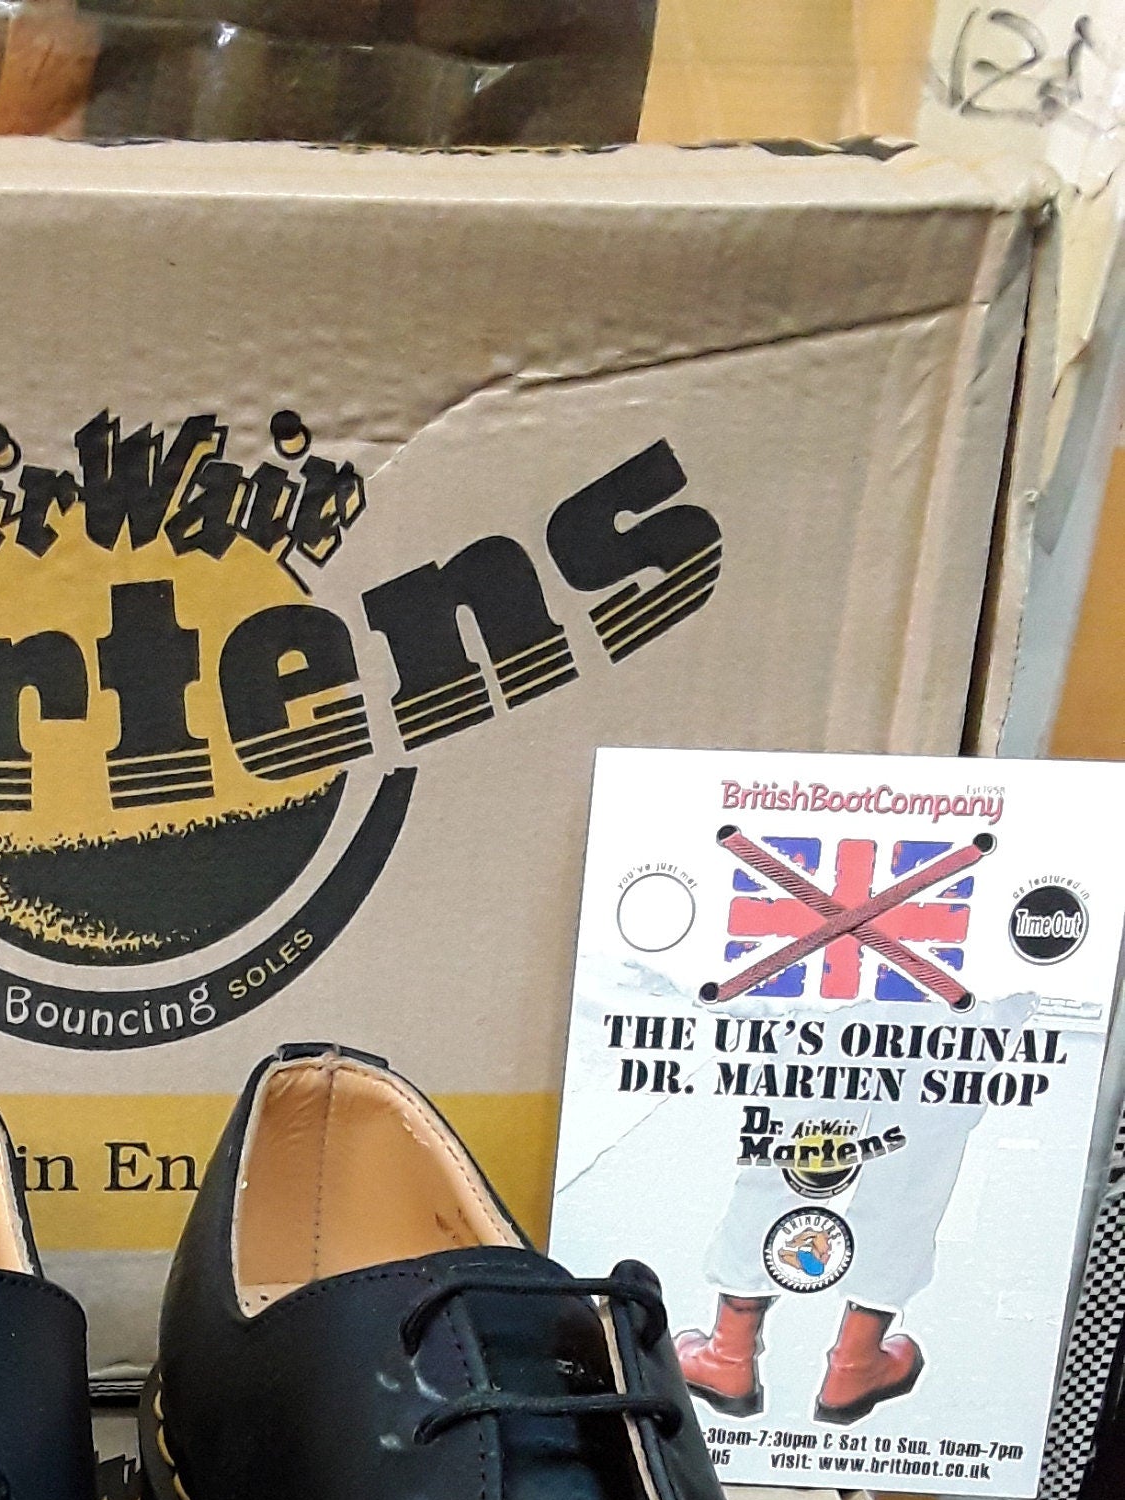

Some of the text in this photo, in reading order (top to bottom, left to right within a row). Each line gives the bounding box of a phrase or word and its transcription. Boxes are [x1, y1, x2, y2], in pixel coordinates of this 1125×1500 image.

[721, 780, 1005, 825] BritishBootCompany
[5, 982, 218, 1037] Bouncing
[227, 927, 315, 1001] SOLES
[603, 1015, 1069, 1065] THE UK'S ORIGINAL
[617, 1059, 1051, 1108] DR. MARTEN SHOP
[737, 1124, 908, 1167] Martens
[791, 1118, 859, 1140] AirWair
[818, 1453, 991, 1480] www.britboot.co.uk
[839, 1434, 868, 1452] Sat
[875, 1435, 891, 1453] to
[897, 1437, 931, 1456] Sun.
[939, 1439, 1024, 1460] 10am-7pm
